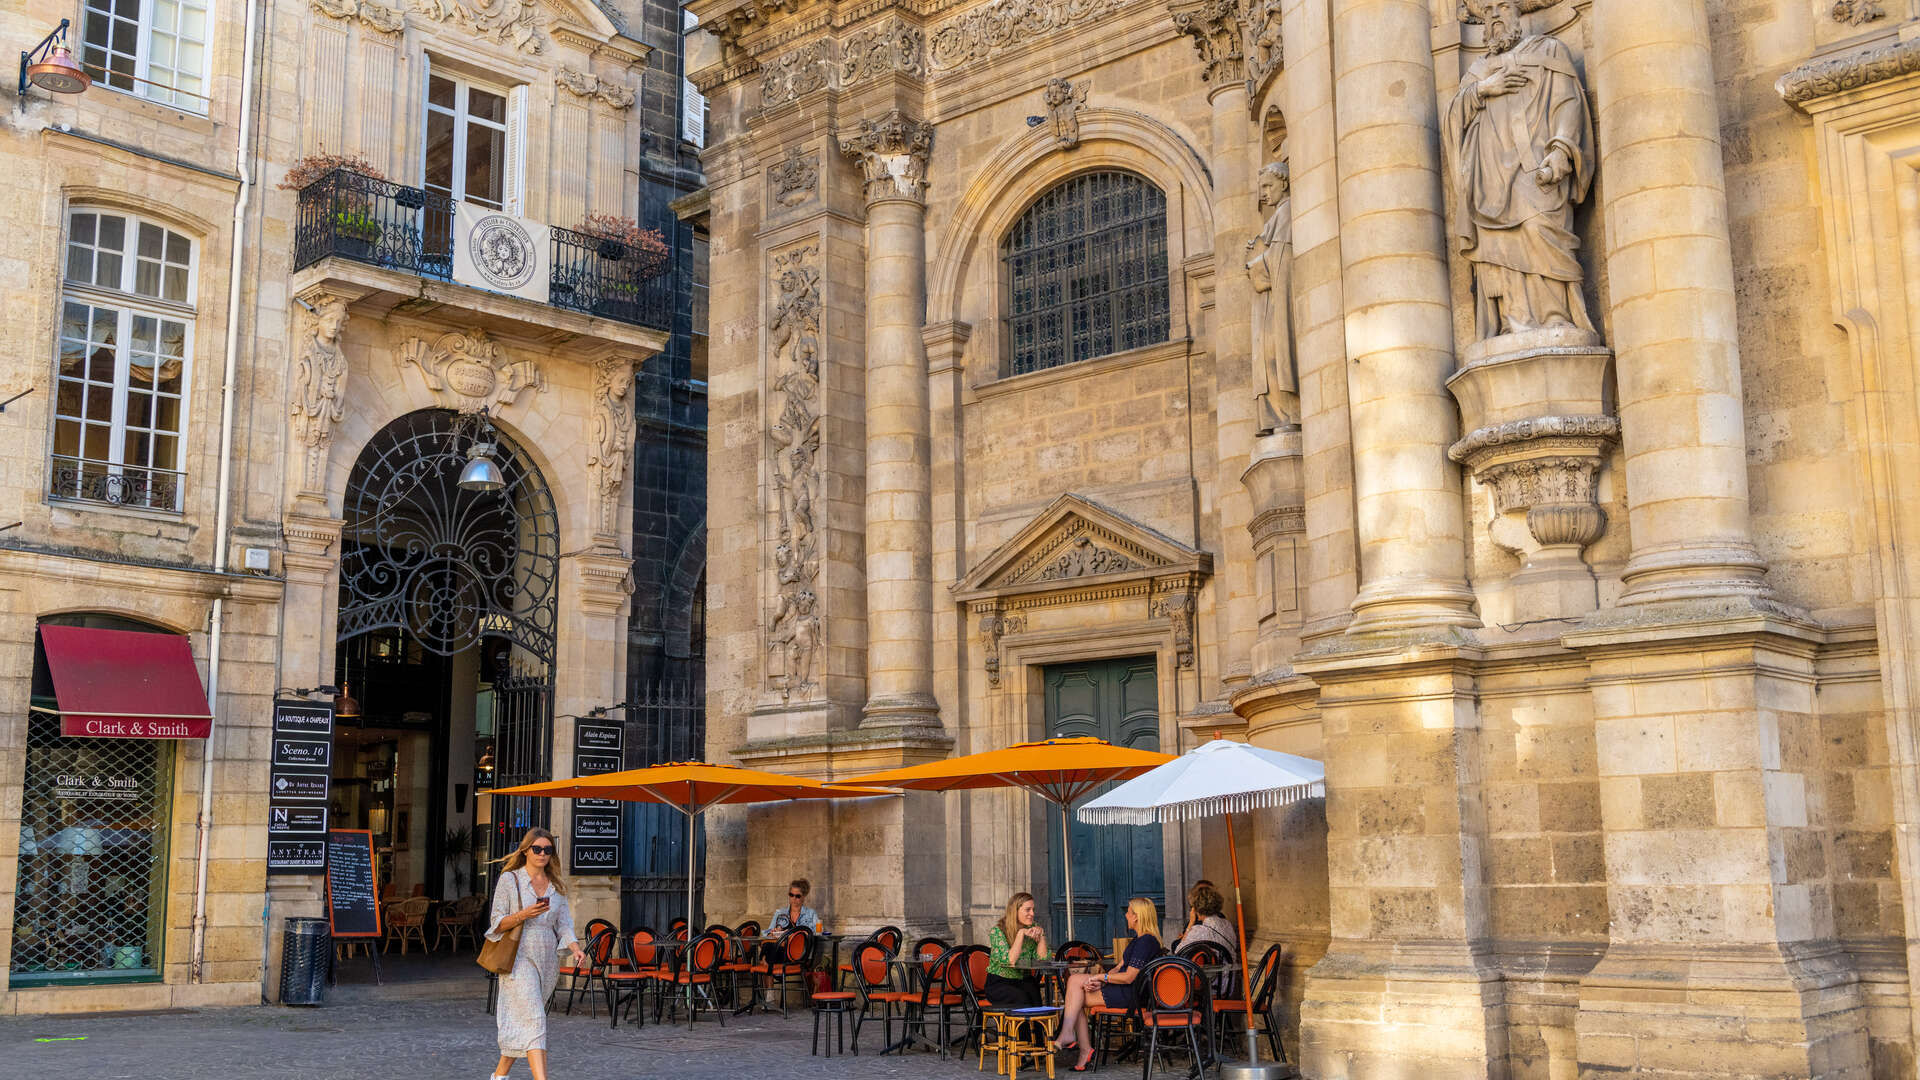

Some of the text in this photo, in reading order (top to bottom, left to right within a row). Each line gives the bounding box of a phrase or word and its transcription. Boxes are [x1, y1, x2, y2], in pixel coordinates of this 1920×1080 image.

[86, 720, 189, 736] Clark & Smith
[281, 744, 324, 756] Sceno. 10
[57, 775, 138, 788] Clark & Smith
[578, 851, 614, 862] LALIQUE
